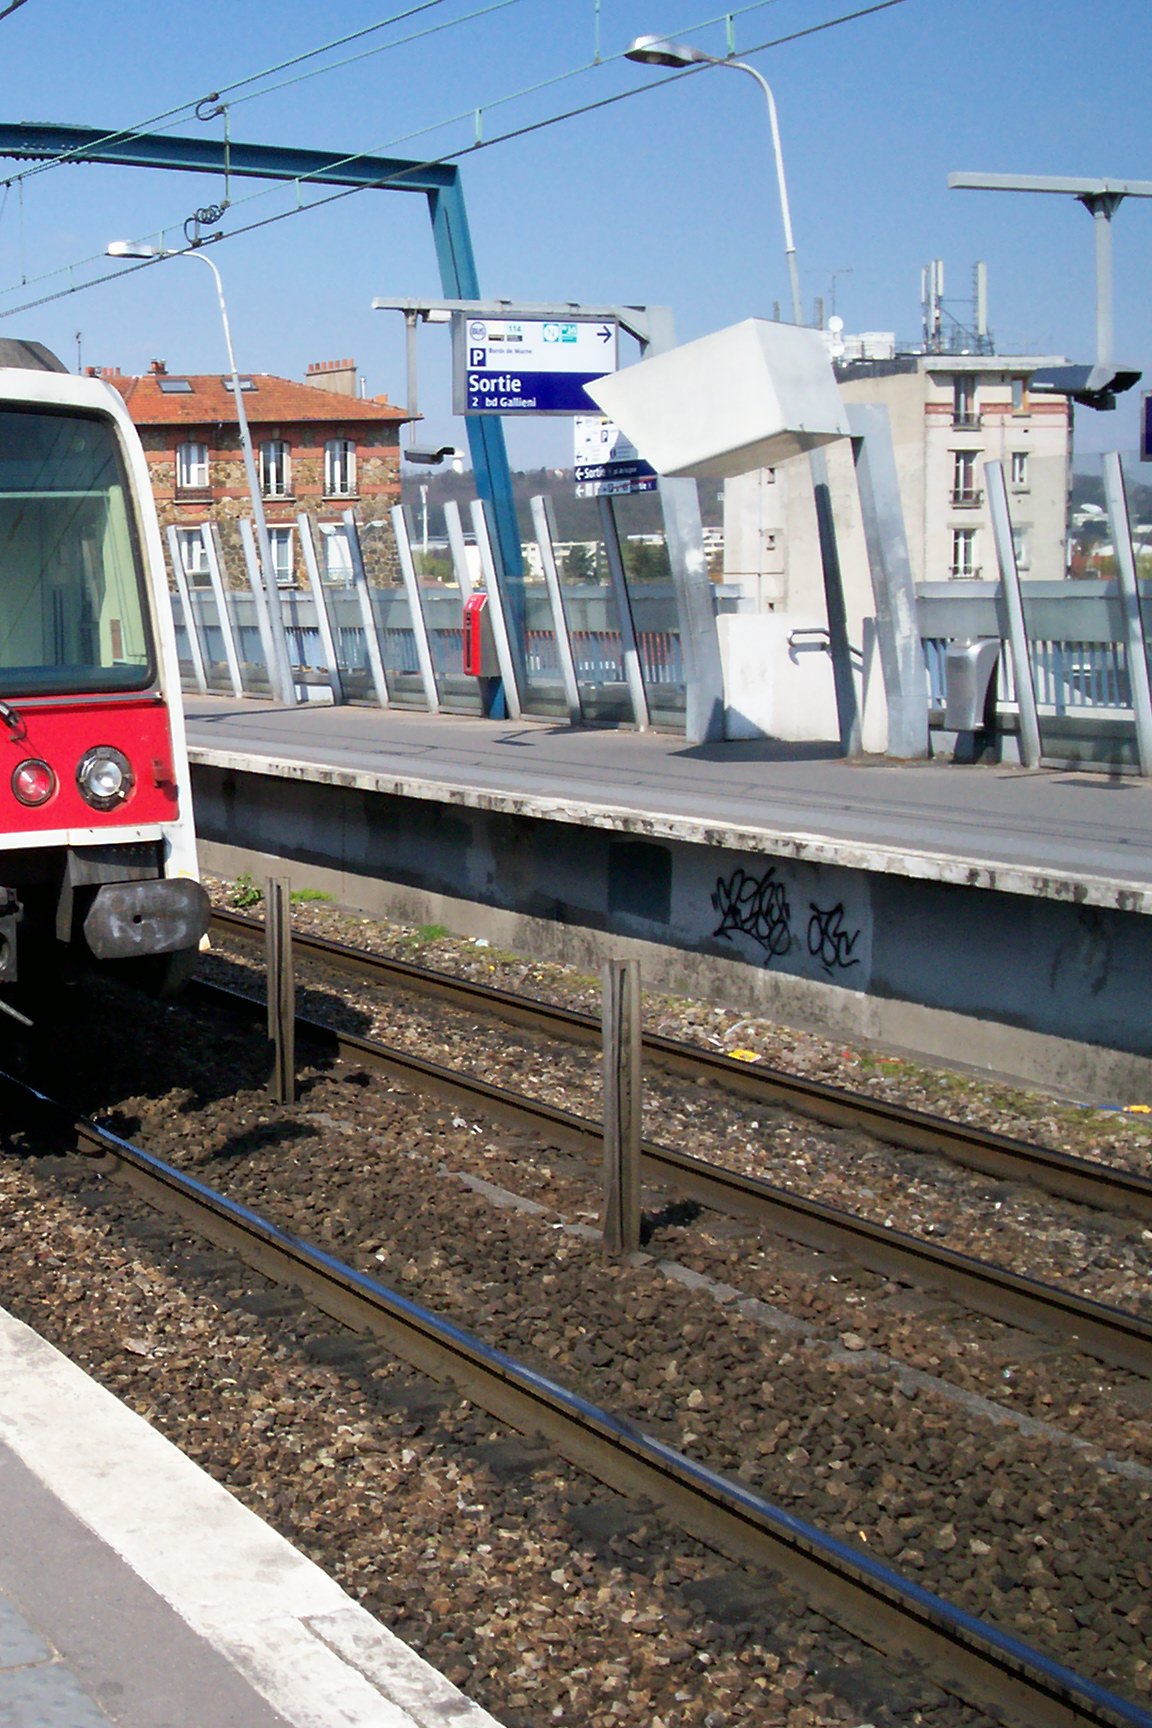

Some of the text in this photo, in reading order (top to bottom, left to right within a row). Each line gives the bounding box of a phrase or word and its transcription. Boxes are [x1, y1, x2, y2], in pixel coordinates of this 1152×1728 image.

[473, 350, 484, 365] P
[469, 374, 521, 393] Sortie
[472, 397, 536, 407] 2 bd Gallieni
[584, 465, 605, 479] Sortie
